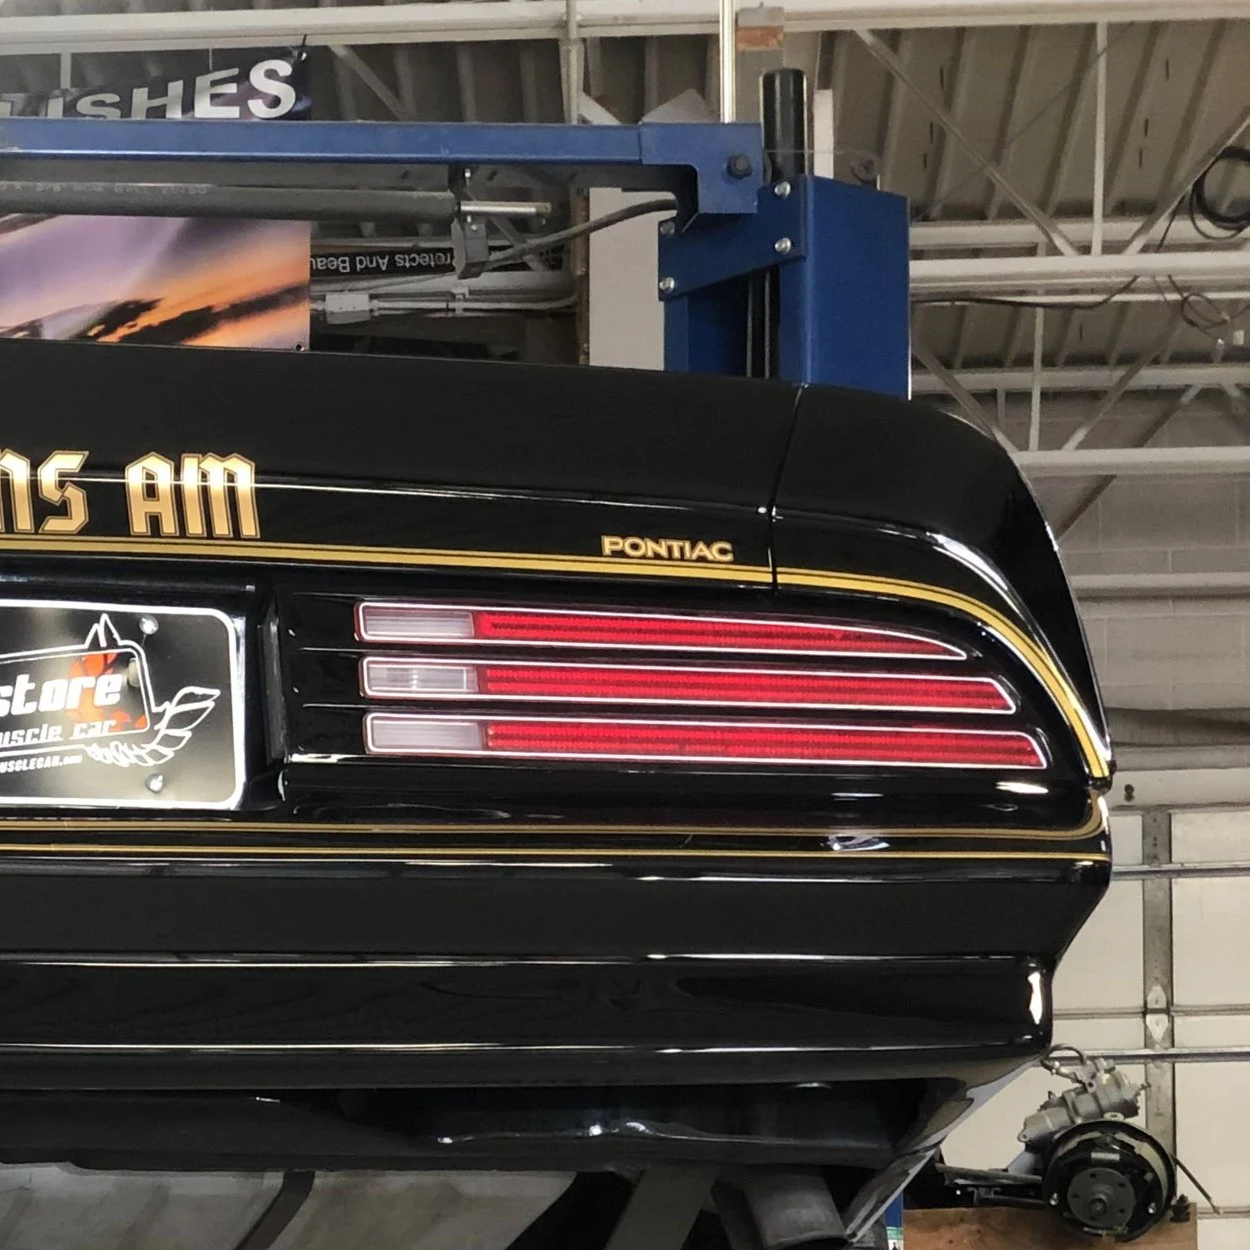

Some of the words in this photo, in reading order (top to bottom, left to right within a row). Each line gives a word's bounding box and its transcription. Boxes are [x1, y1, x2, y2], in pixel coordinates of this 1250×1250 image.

[356, 254, 388, 271] And
[395, 252, 453, 268] rotects
[124, 451, 260, 538] AM
[600, 534, 734, 562] PONTIAC
[69, 719, 117, 740] car
